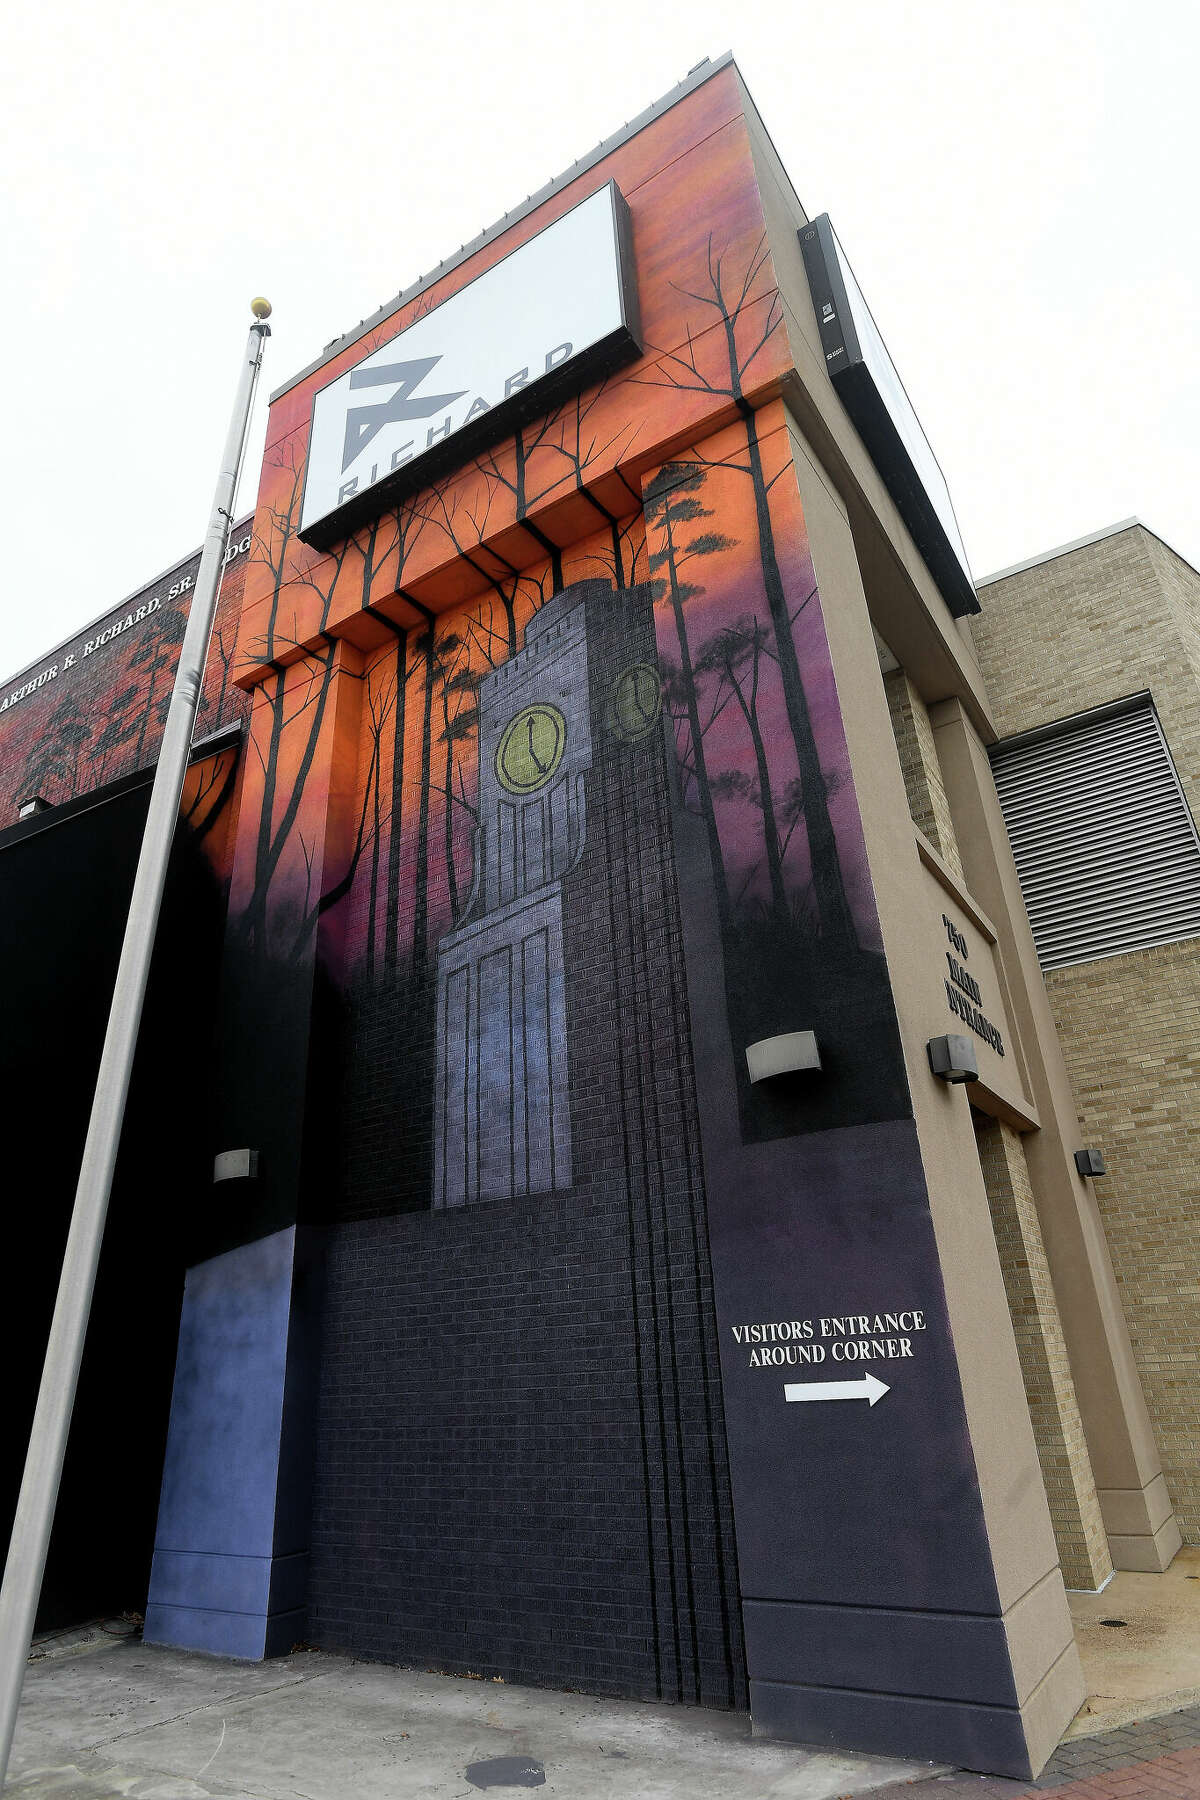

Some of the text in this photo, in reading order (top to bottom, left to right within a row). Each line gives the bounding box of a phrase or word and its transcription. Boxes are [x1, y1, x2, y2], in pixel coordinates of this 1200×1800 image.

[337, 342, 574, 506] RICHARD
[0, 665, 60, 714] ARTHUR
[62, 654, 79, 671] R.
[82, 597, 162, 659] RICHARD,
[944, 977, 1005, 1057] NTRANCE
[731, 1310, 927, 1344] VISITORS ENTRANCE
[749, 1338, 914, 1368] AROUND CORNER
